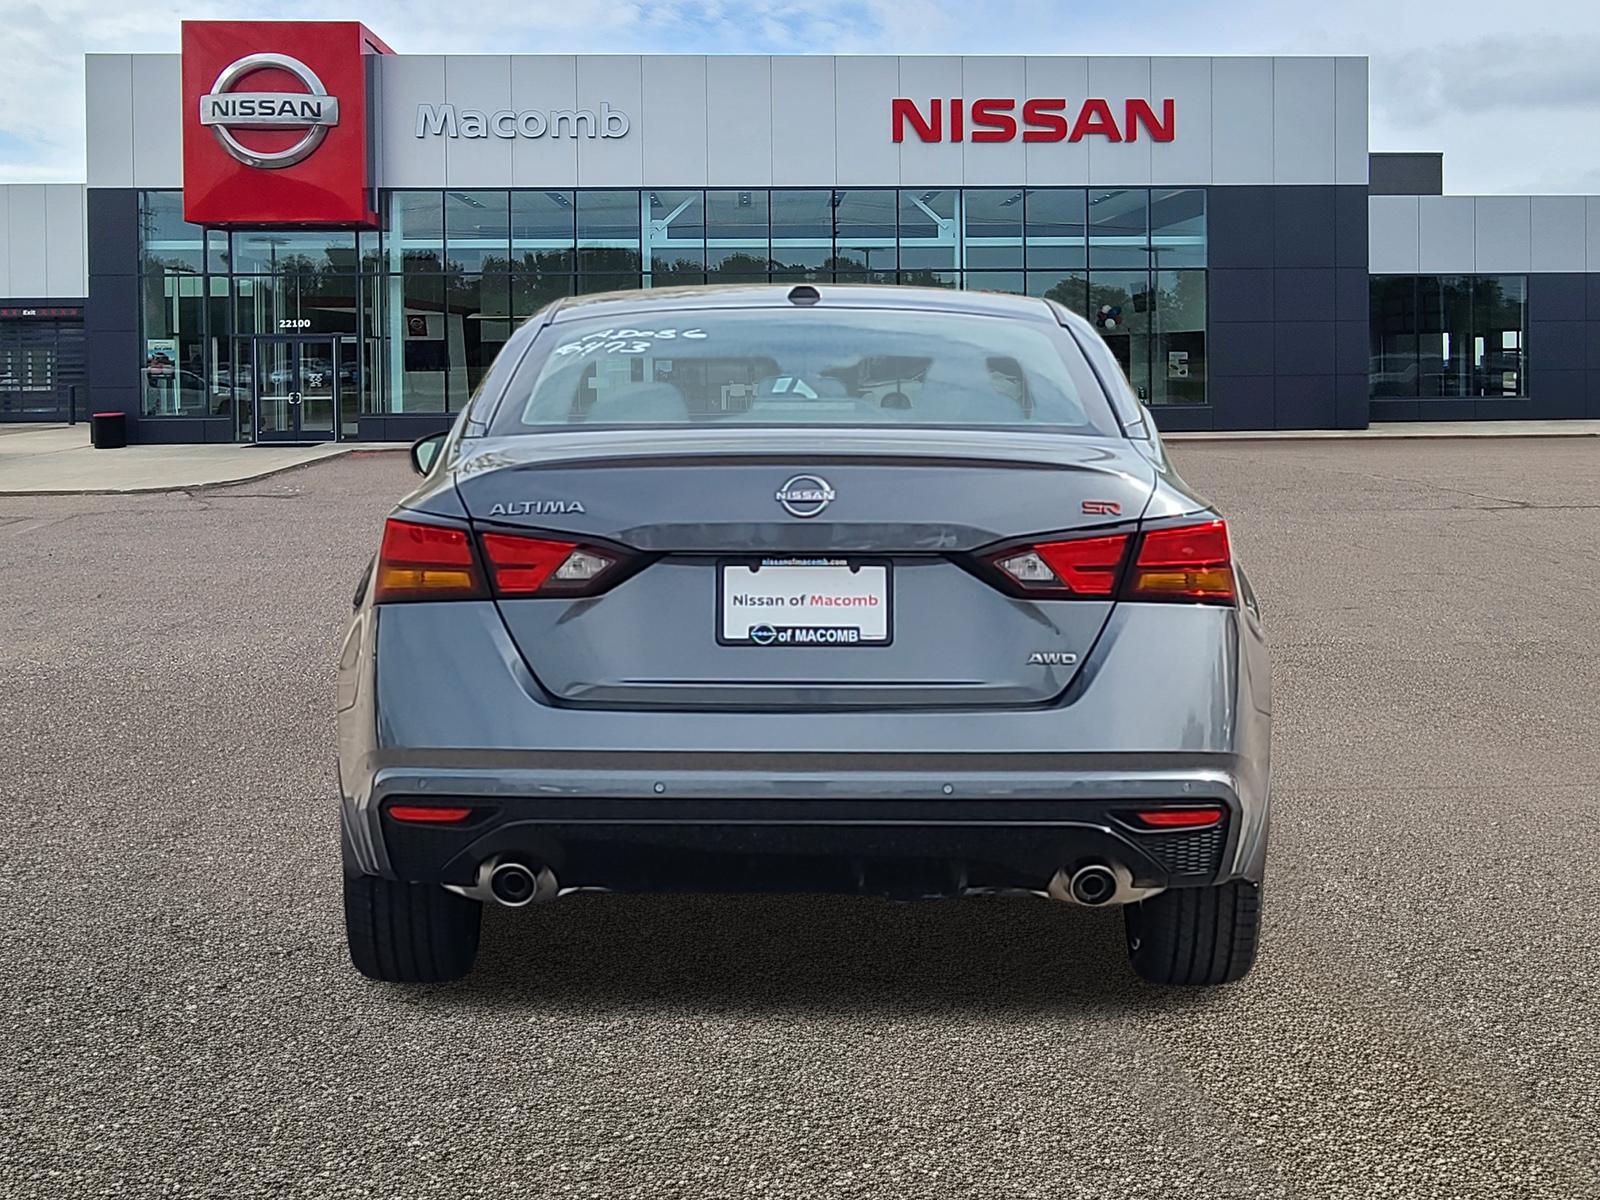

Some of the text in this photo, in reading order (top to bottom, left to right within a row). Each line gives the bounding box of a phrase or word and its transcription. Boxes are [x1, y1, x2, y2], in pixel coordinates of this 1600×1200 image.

[211, 100, 322, 117] NISSAN
[415, 102, 630, 138] Macomb
[892, 98, 1176, 143] NISSAN
[279, 319, 311, 328] 22100
[775, 490, 836, 501] NISSAN
[489, 500, 585, 516] ALTIMA
[1082, 501, 1121, 516] SR
[733, 594, 879, 607] Nissan of Macomb
[778, 629, 859, 642] of MACOMB
[1026, 652, 1077, 665] AWD
